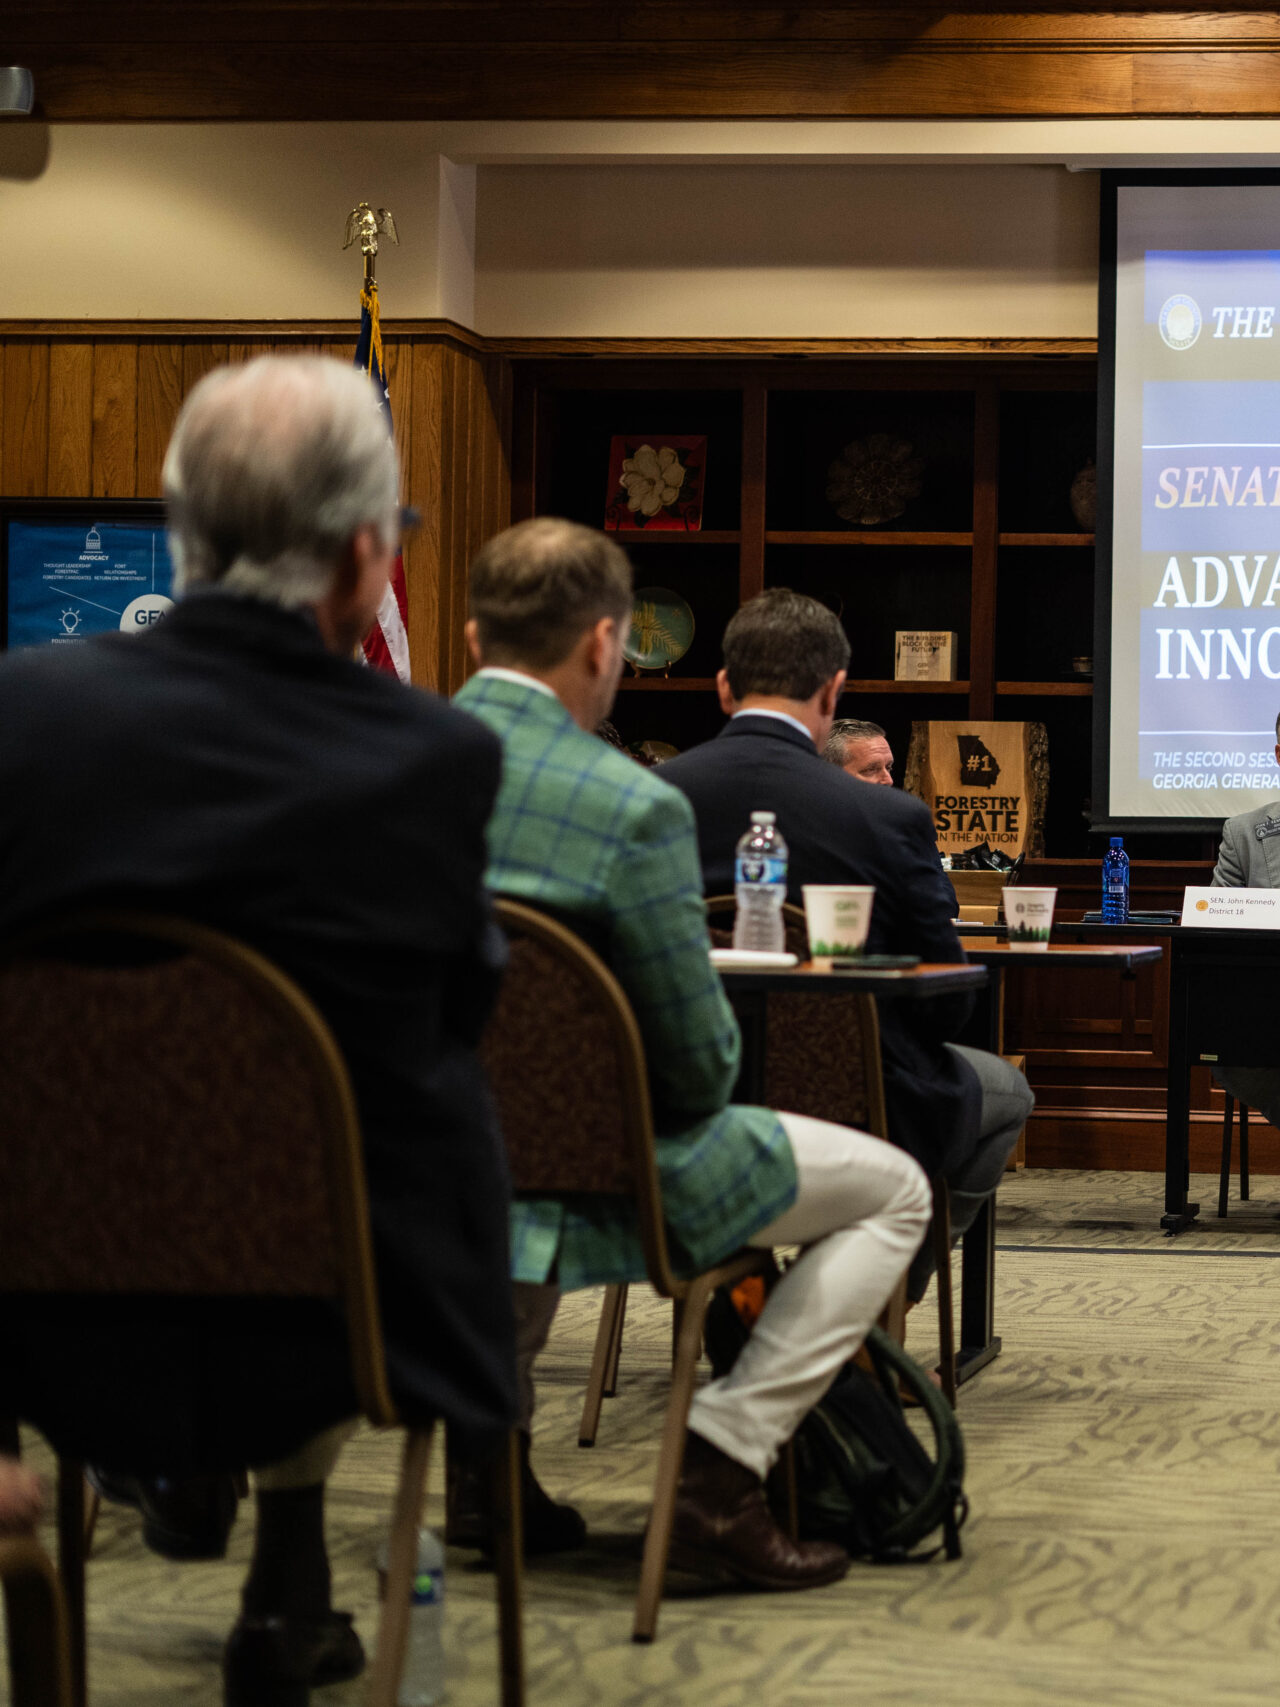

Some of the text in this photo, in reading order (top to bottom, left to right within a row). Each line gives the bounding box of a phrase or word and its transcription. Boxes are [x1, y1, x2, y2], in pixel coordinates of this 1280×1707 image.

[1212, 306, 1276, 338] THE
[966, 755, 992, 771] #1
[1153, 751, 1182, 768] THE
[1184, 751, 1245, 768] SECOND
[1152, 773, 1218, 789] GEORGIA
[935, 796, 1021, 810] FORESTRY
[935, 810, 1019, 833] STATE
[951, 832, 972, 842] THE
[975, 832, 1018, 843] NATION
[1246, 898, 1276, 906] Kennedy
